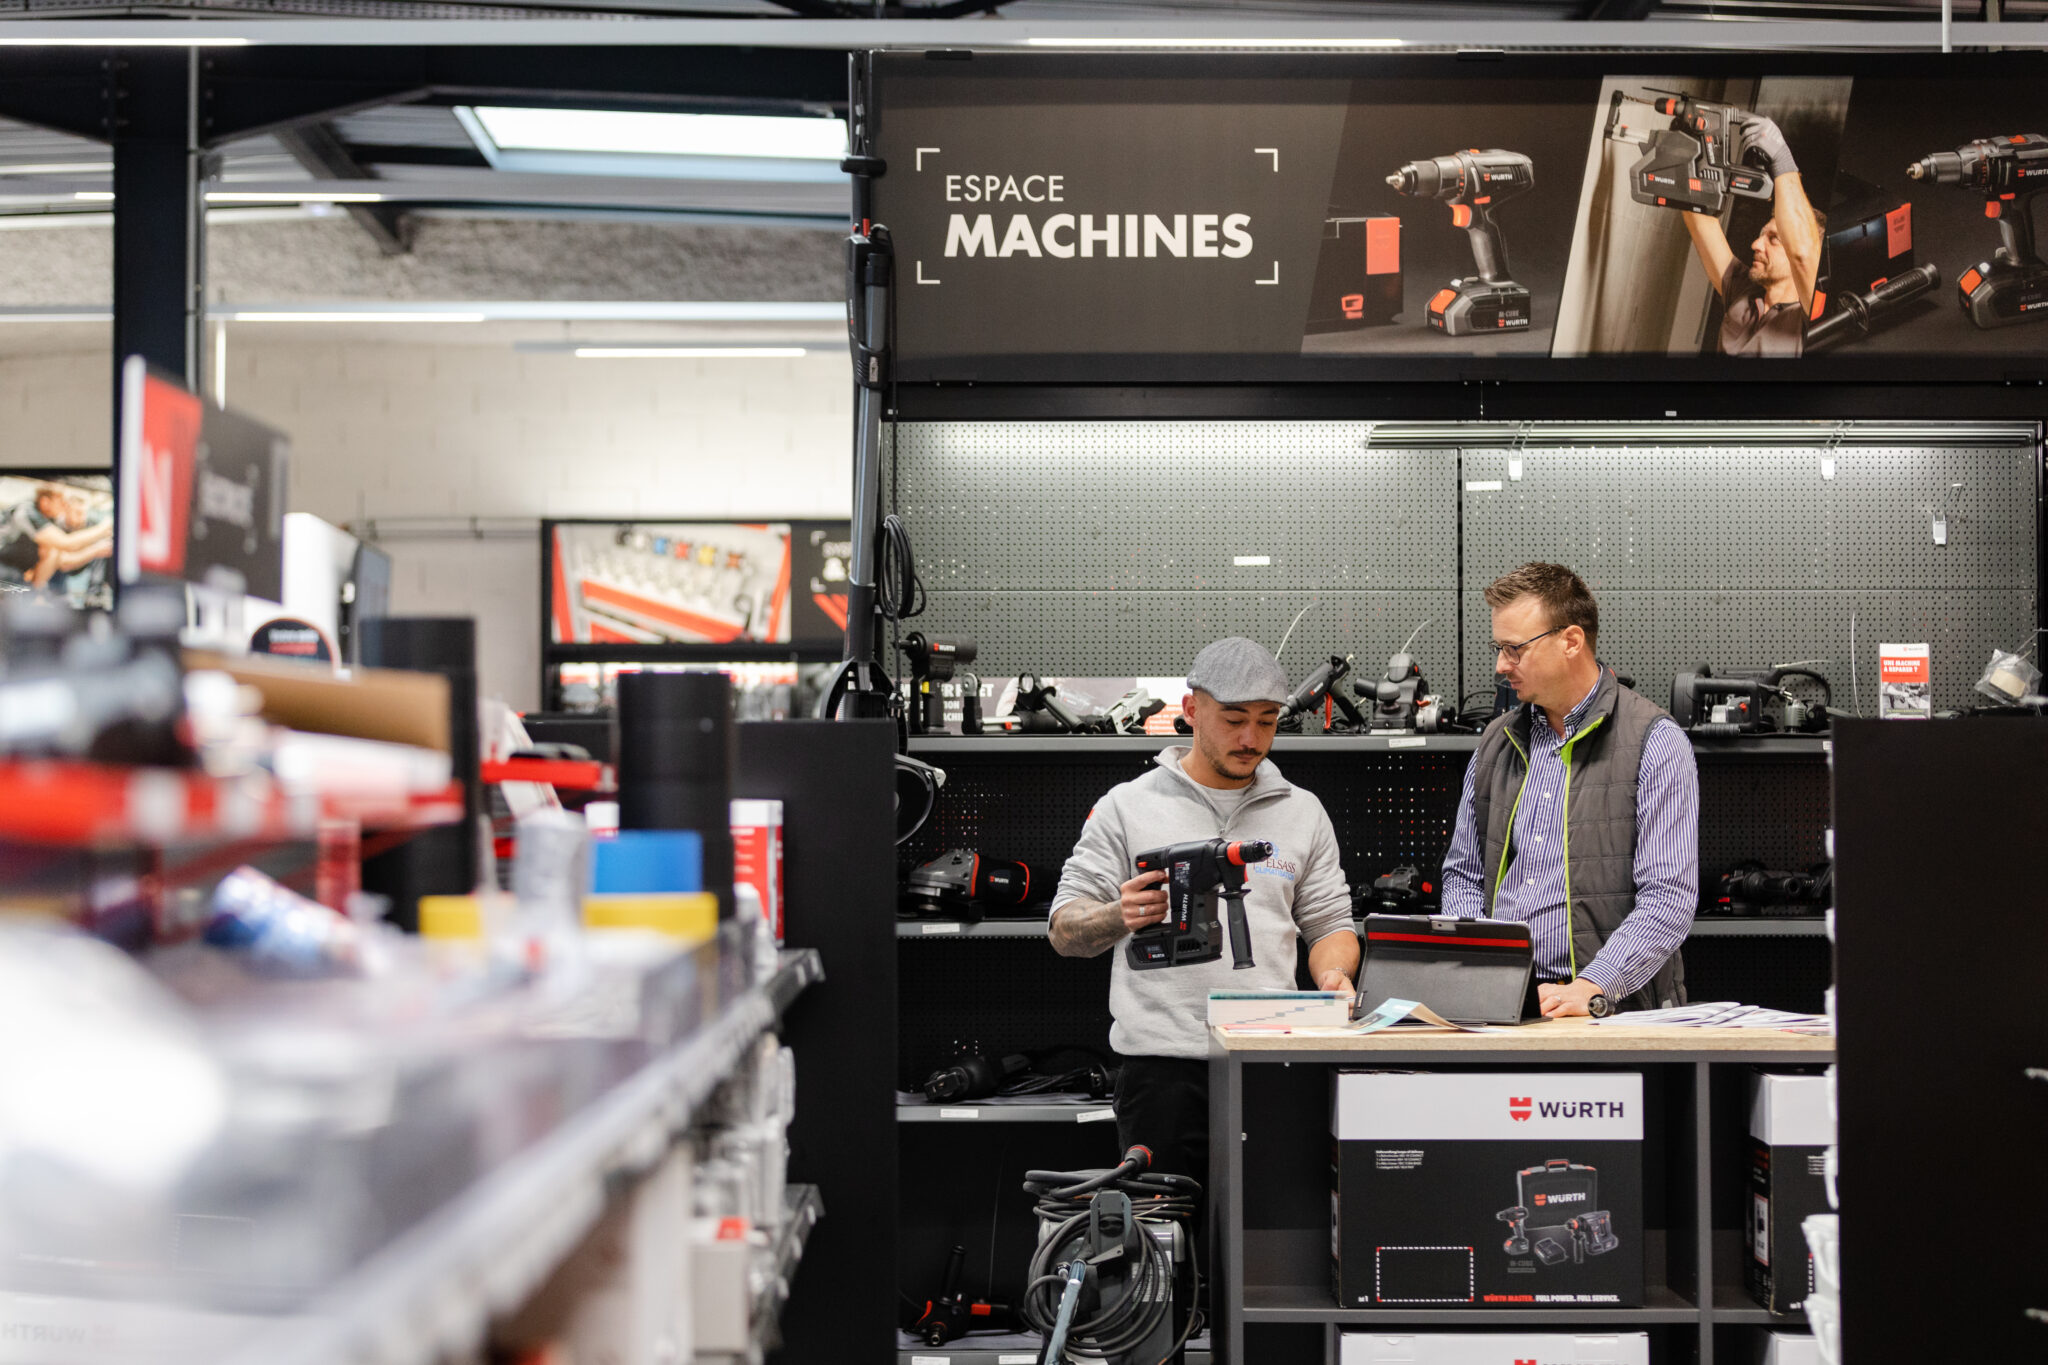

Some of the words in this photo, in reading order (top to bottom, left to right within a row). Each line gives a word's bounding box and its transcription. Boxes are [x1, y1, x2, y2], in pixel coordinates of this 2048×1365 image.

[945, 174, 1064, 203] ESPACE
[944, 213, 1253, 259] MACHINES
[1266, 858, 1296, 874] ELSASS
[1538, 1101, 1625, 1119] WÜRTH
